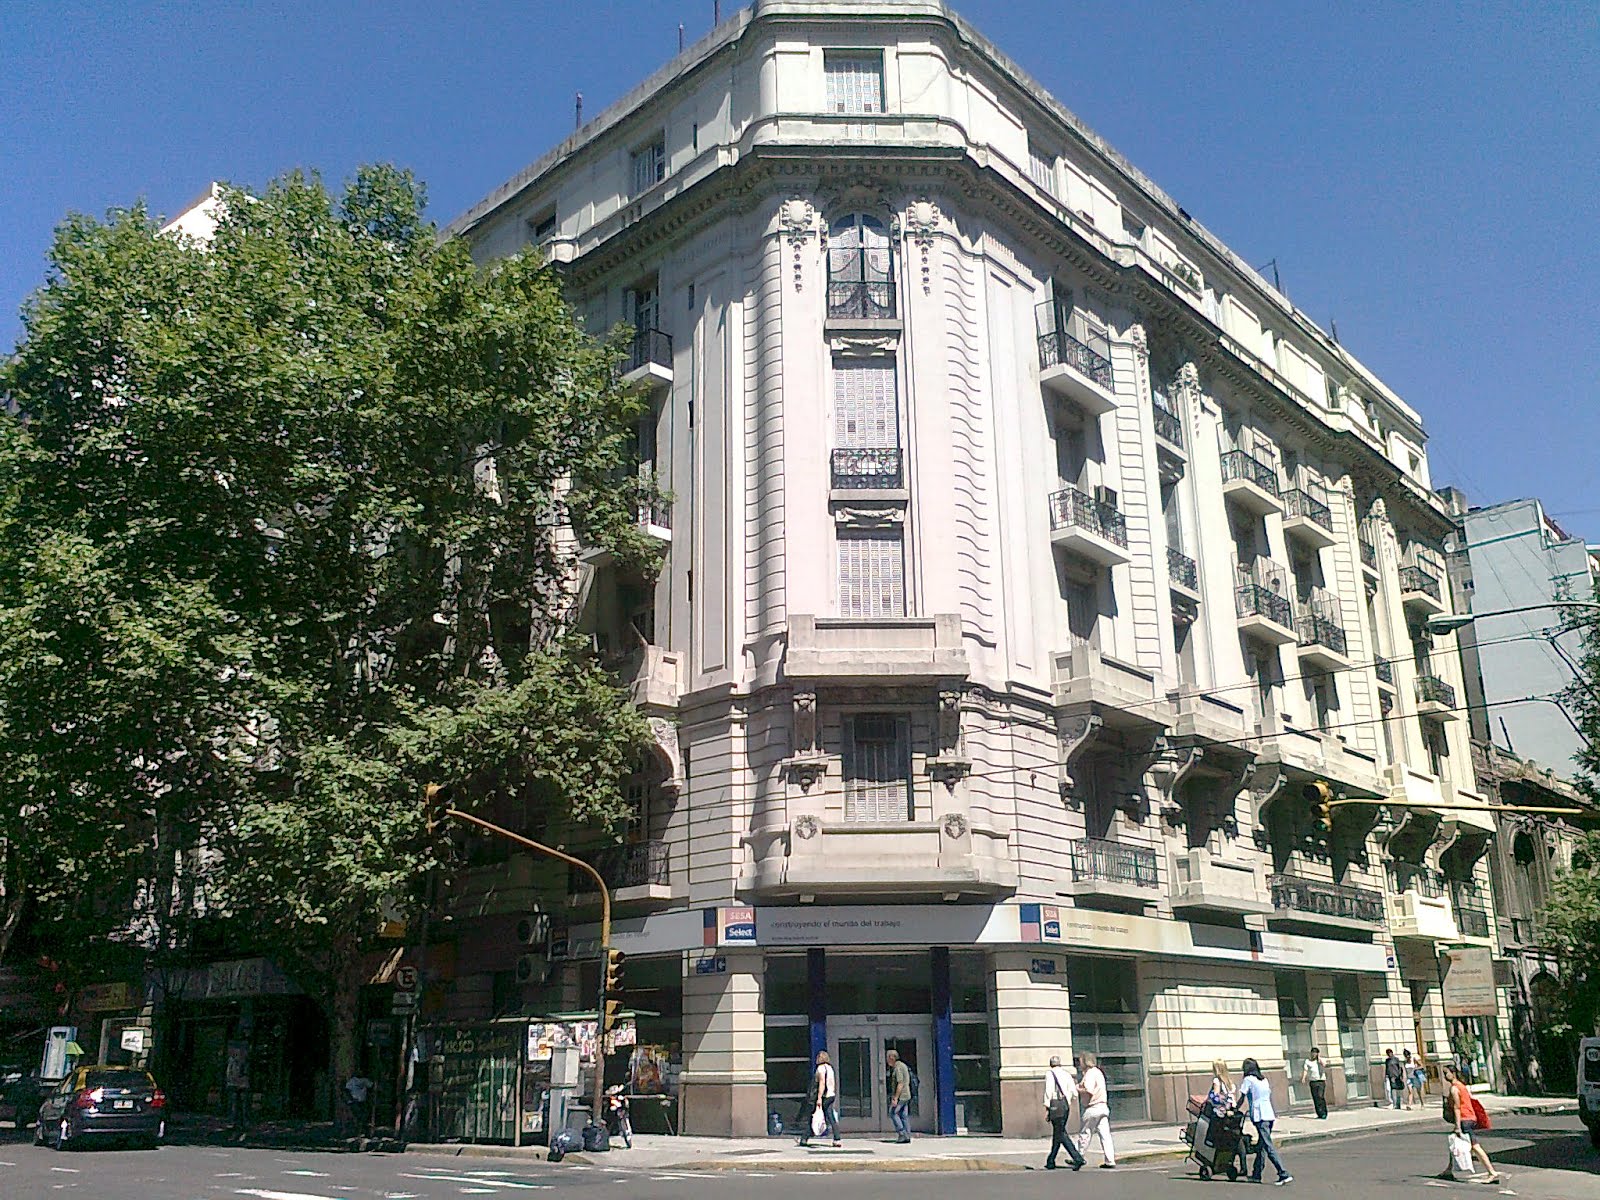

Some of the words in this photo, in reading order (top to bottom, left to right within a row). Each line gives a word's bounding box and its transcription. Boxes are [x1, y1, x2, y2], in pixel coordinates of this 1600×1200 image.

[730, 911, 752, 920] SESA
[770, 919, 822, 929] construyendo
[823, 919, 830, 928] el
[832, 919, 859, 928] mundo
[860, 919, 872, 928] del
[874, 919, 901, 929] trabajo
[728, 927, 753, 937] Select
